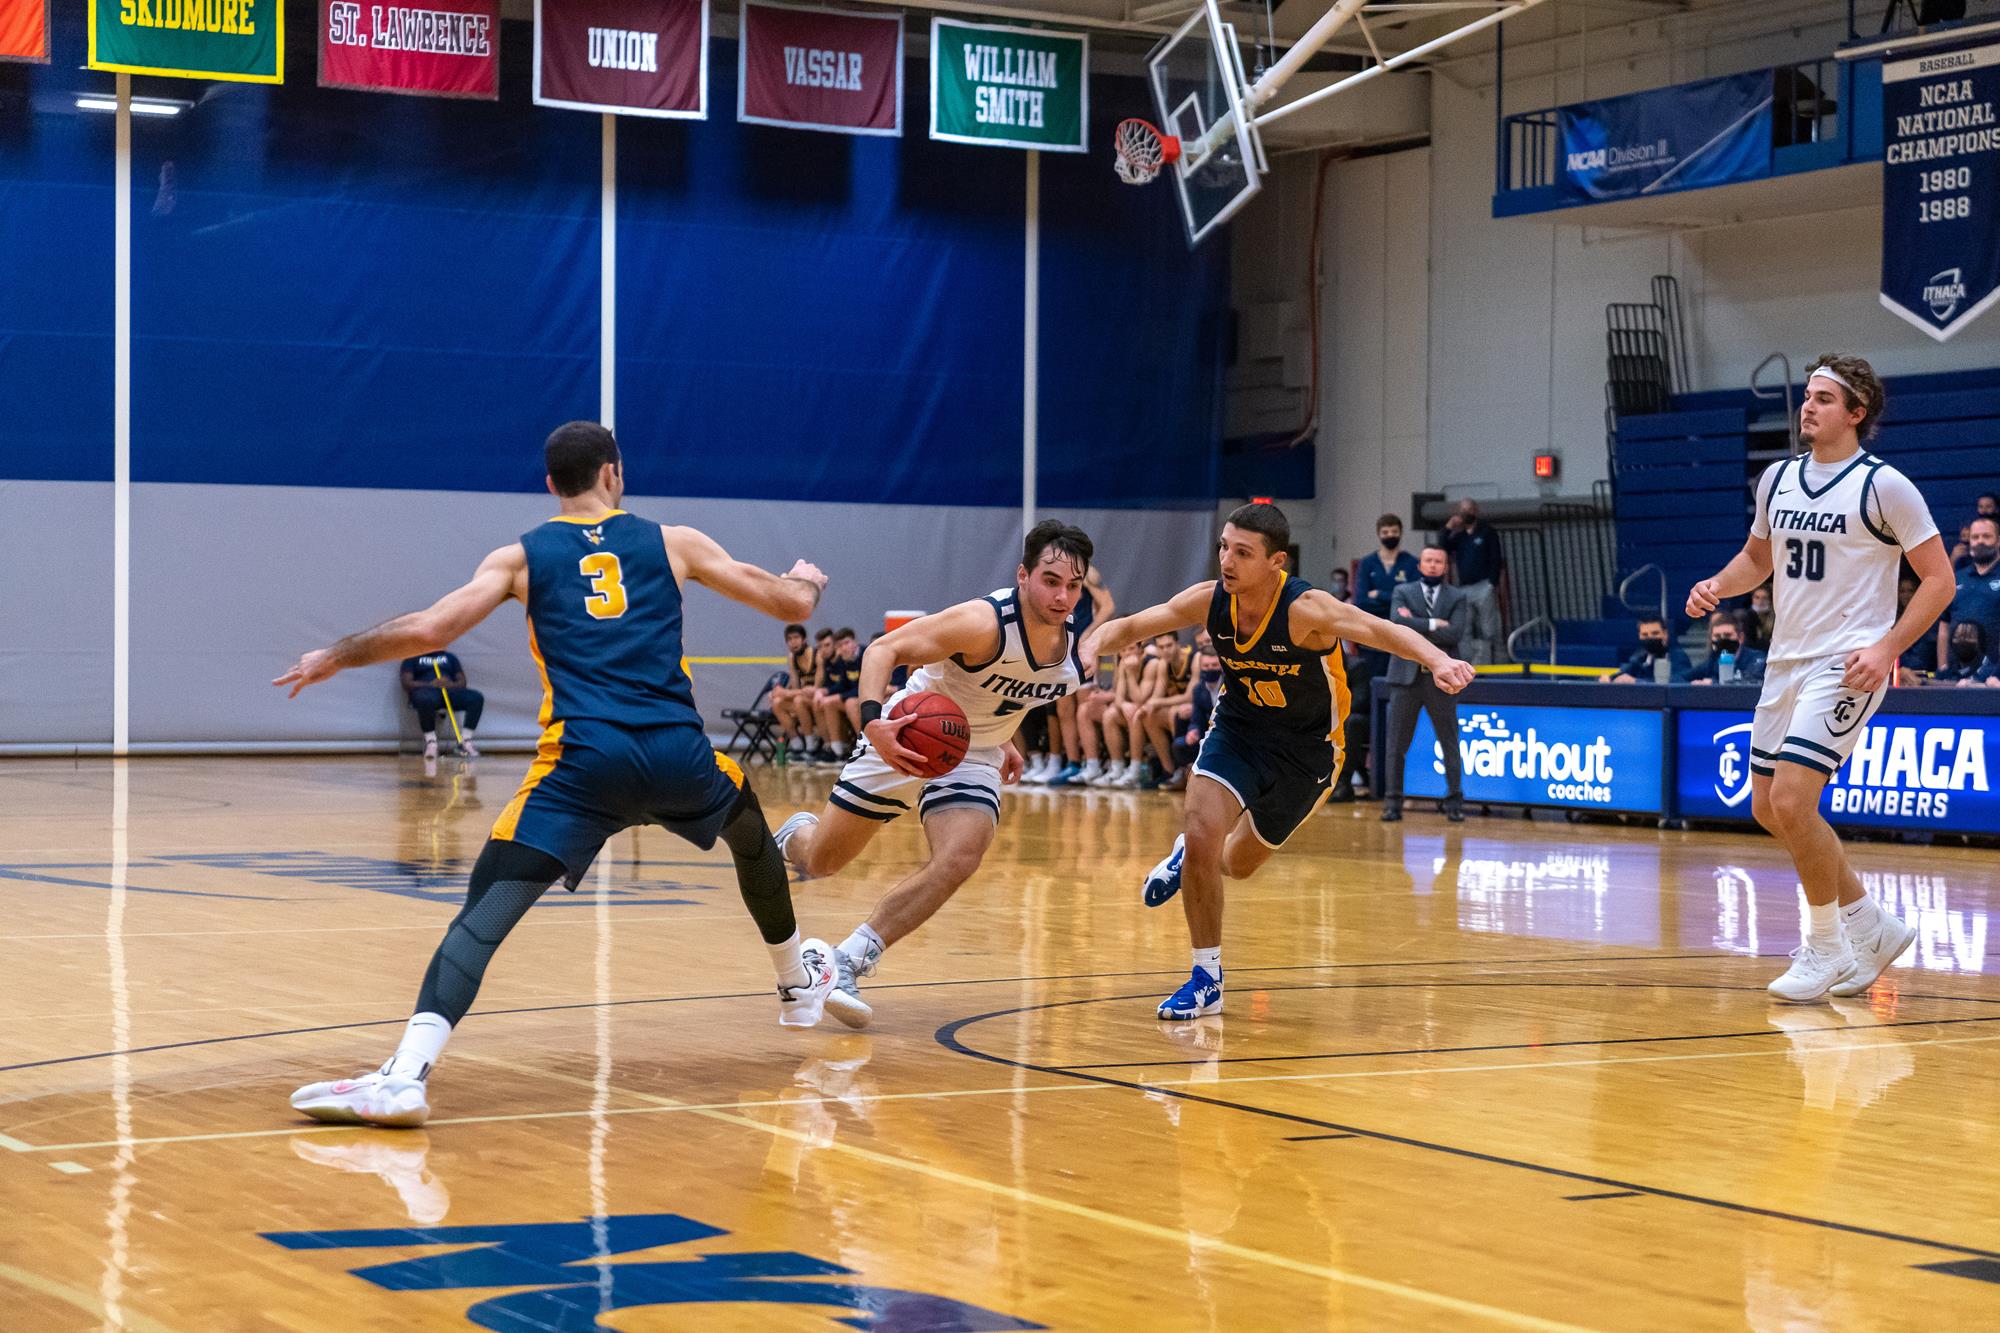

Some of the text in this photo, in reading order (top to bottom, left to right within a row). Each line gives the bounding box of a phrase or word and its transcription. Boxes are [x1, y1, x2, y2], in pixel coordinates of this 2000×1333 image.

[120, 0, 255, 35] SKIDMORE
[329, 1, 490, 56] ST. LAWRENCE
[588, 27, 657, 72] UNION
[1919, 54, 1975, 72] BASEBALL
[784, 46, 863, 91] VASSAR
[963, 43, 1057, 89] WILLIAM
[975, 86, 1045, 128] SMITH
[1920, 79, 1974, 107] NCAA
[1897, 102, 1996, 137] NATIONAL
[1567, 149, 1605, 171] NCAA
[1609, 145, 1656, 164] Division
[1919, 167, 1971, 193] 1980
[1919, 197, 1971, 223] 1988
[1923, 283, 1966, 302] ITHACA
[1773, 509, 1847, 535] ITHACA
[1785, 538, 1826, 582] 30
[579, 552, 628, 620] 3
[980, 673, 1068, 700] ITHACA
[1239, 676, 1287, 708] 10
[1547, 781, 1613, 802] coaches
[1830, 787, 1949, 819] BOMBERS
